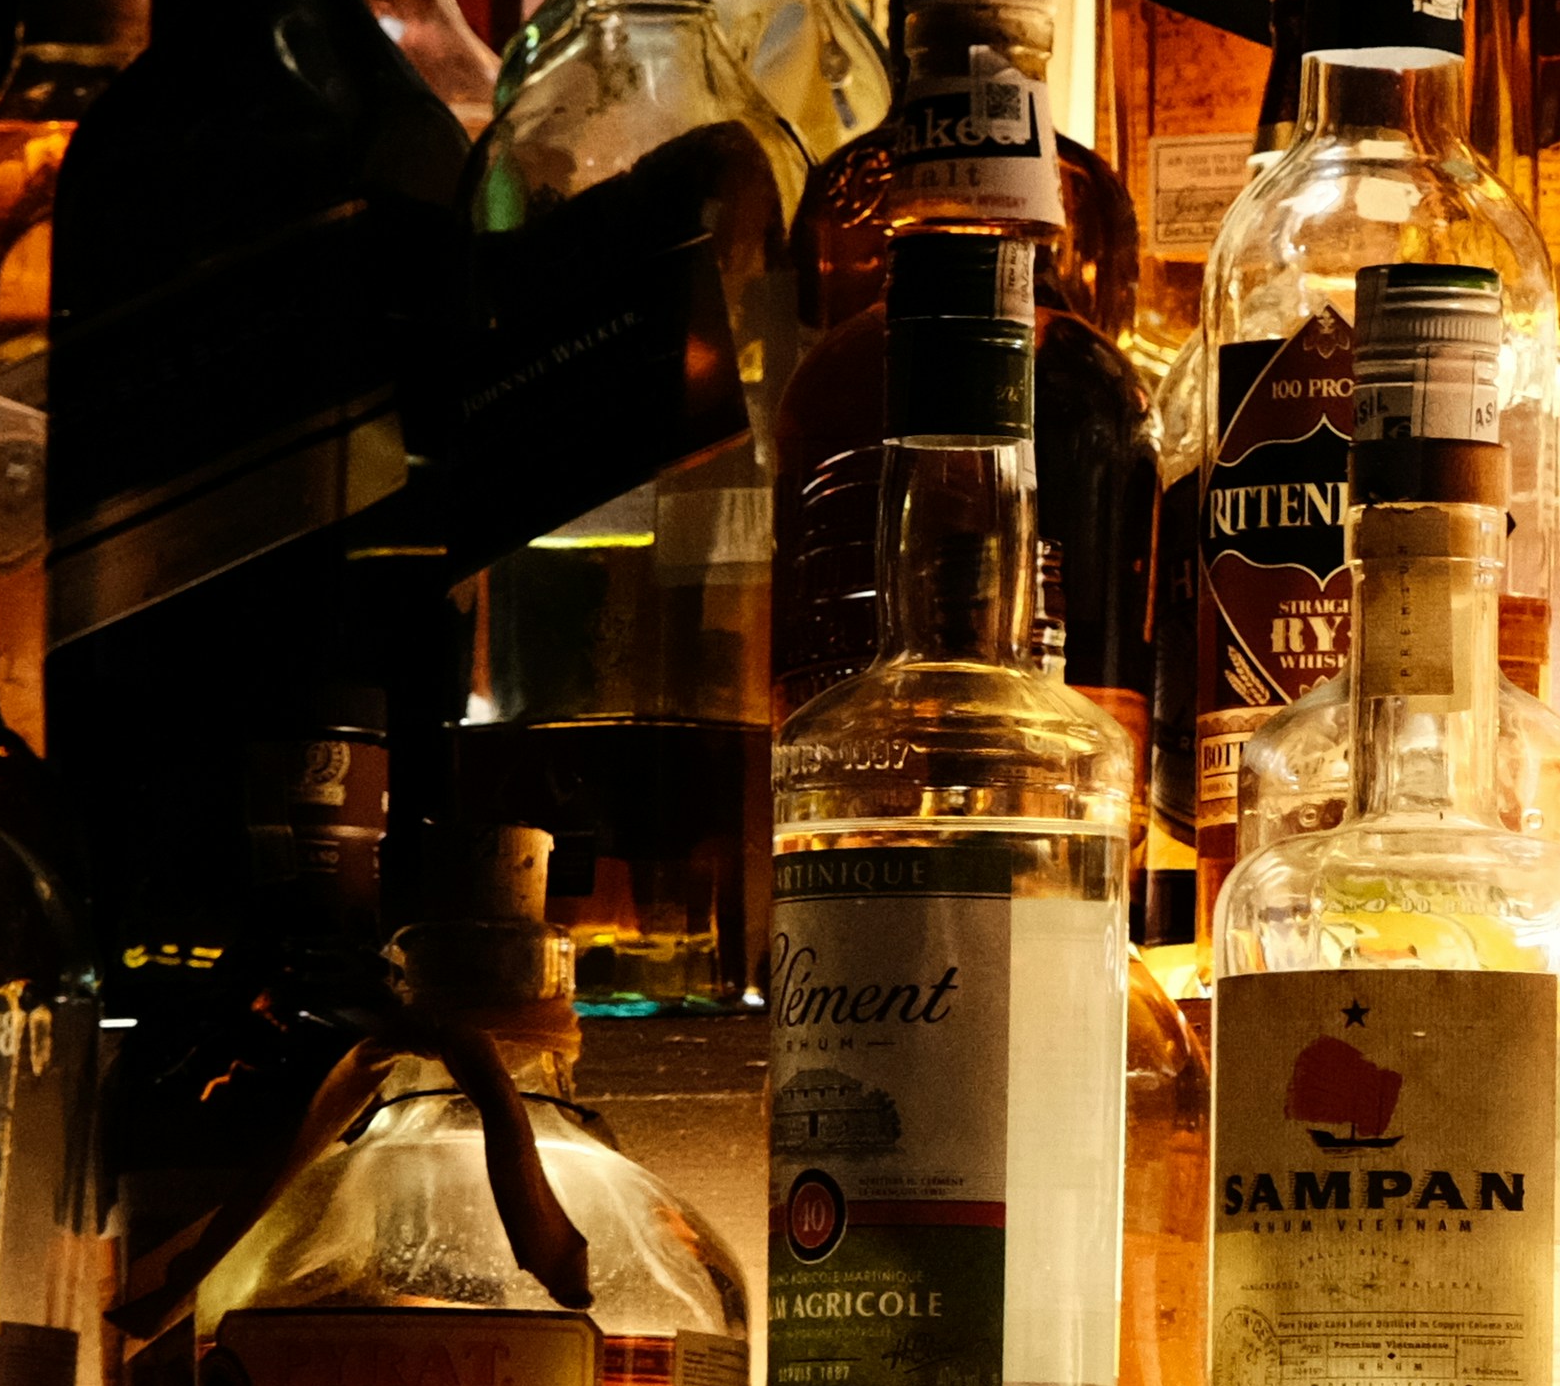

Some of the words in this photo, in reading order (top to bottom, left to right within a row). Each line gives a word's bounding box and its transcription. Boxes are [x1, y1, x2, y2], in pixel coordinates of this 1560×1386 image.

[1272, 380, 1301, 399] 100
[1400, 545, 1411, 678] PREMIUM
[1271, 616, 1352, 654] RY
[1224, 1170, 1524, 1215] SAMPAN
[1253, 1220, 1313, 1234] RHUM
[1337, 1219, 1473, 1234] VIETNAM
[844, 1270, 925, 1284] MARTINIQUE
[1399, 1281, 1483, 1291] NATURAL
[793, 1291, 943, 1318] AGRICOLE
[1376, 1319, 1416, 1330] Distilled
[1334, 1340, 1381, 1350] Premium
[1386, 1340, 1449, 1351] Vietnamese
